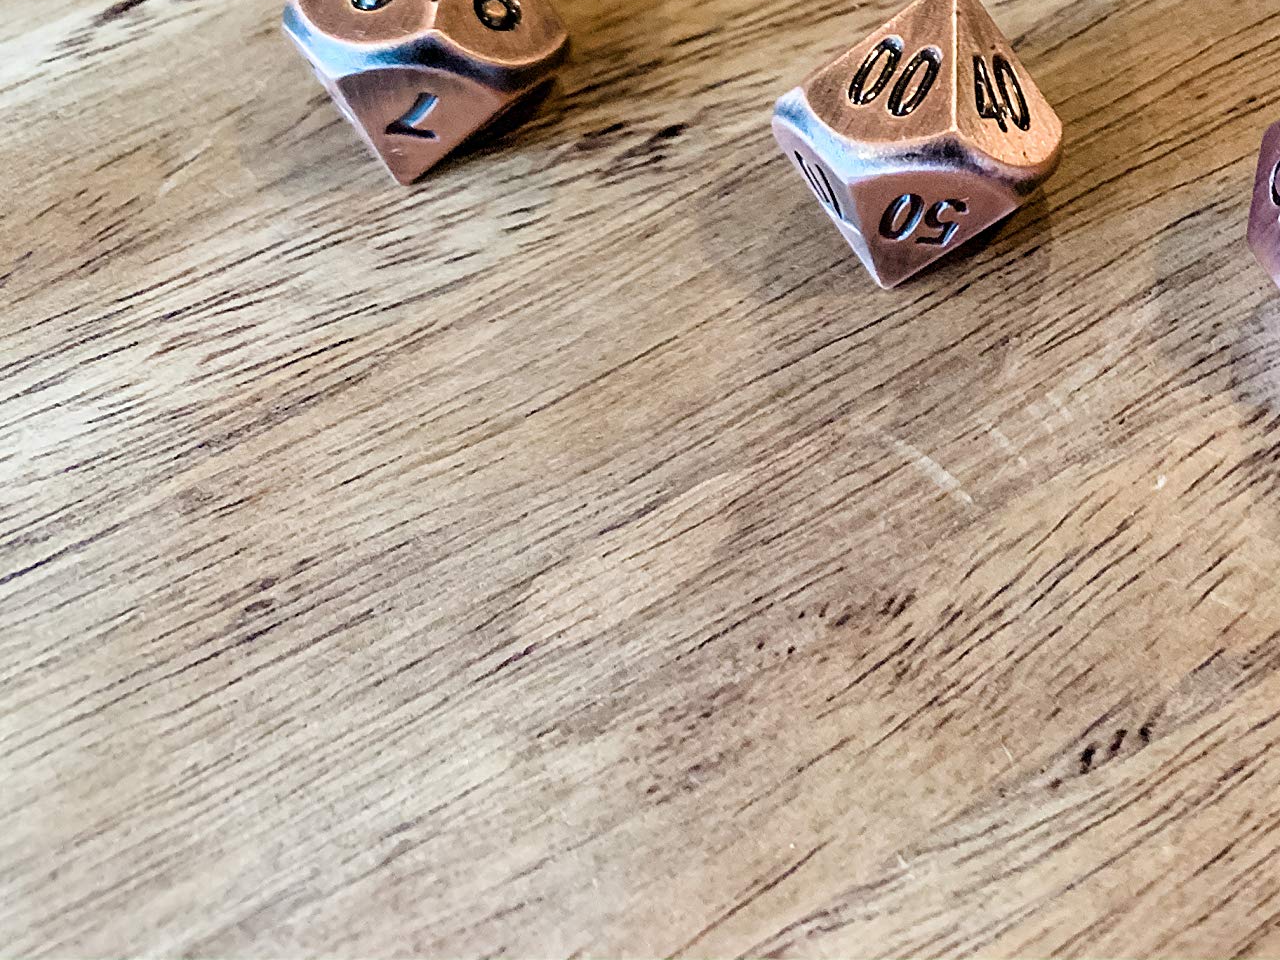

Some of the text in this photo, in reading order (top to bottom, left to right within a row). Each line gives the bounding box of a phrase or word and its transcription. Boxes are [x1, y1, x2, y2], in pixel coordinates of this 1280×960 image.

[847, 35, 943, 117] 00
[972, 53, 1032, 134] 40
[383, 91, 440, 142] 7
[877, 192, 970, 248] 50
